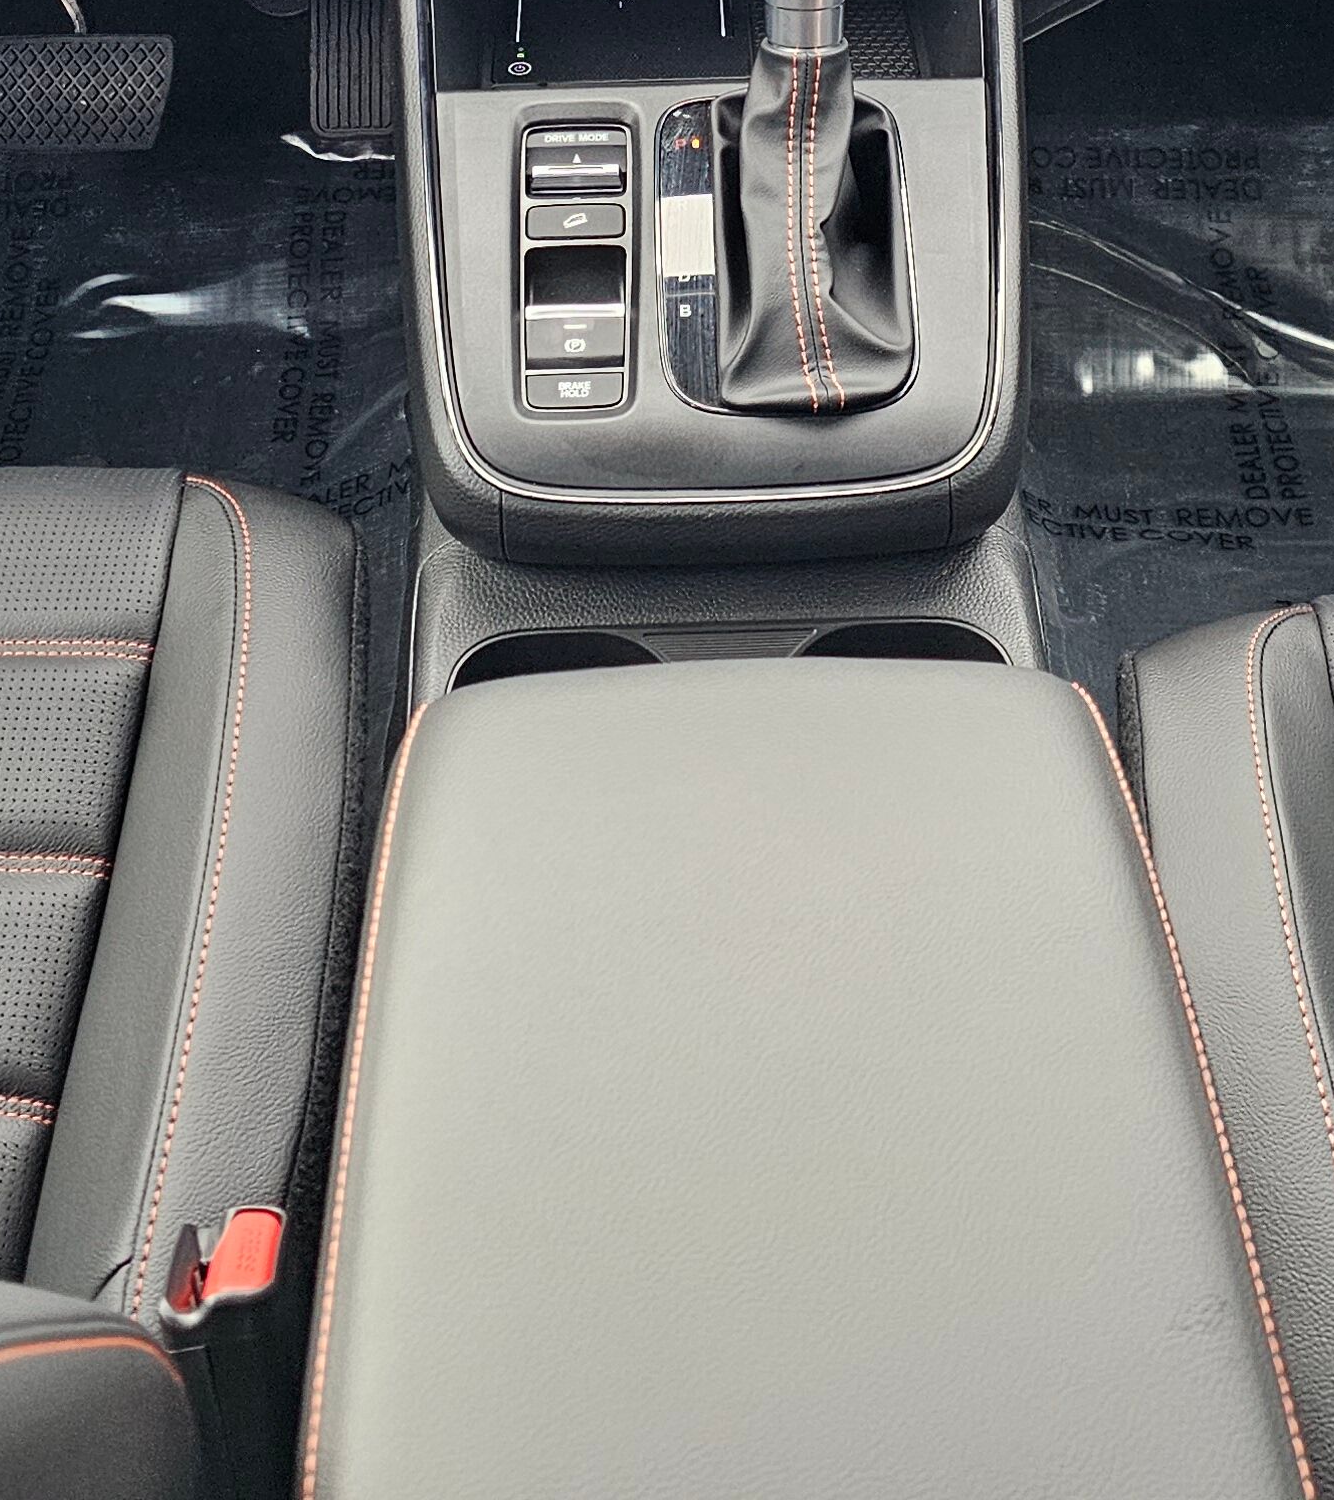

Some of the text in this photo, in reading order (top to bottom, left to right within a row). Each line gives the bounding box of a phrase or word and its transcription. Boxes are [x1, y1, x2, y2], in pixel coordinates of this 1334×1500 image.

[543, 133, 609, 143] DRIVE MODE
[1088, 146, 1261, 172] PROTECTIVE
[1154, 177, 1264, 201] DEALER
[320, 210, 348, 302] DEALER
[24, 276, 63, 361] COVER
[679, 304, 693, 318] B
[315, 320, 345, 380] MUST
[558, 381, 592, 390] BRAKE
[560, 389, 590, 398] HOLD
[270, 366, 307, 444] COVER
[1229, 422, 1271, 501] DEALER
[1072, 503, 1155, 526] MUST
[1174, 505, 1315, 530] REMOVE
[1137, 527, 1258, 552] COVER
